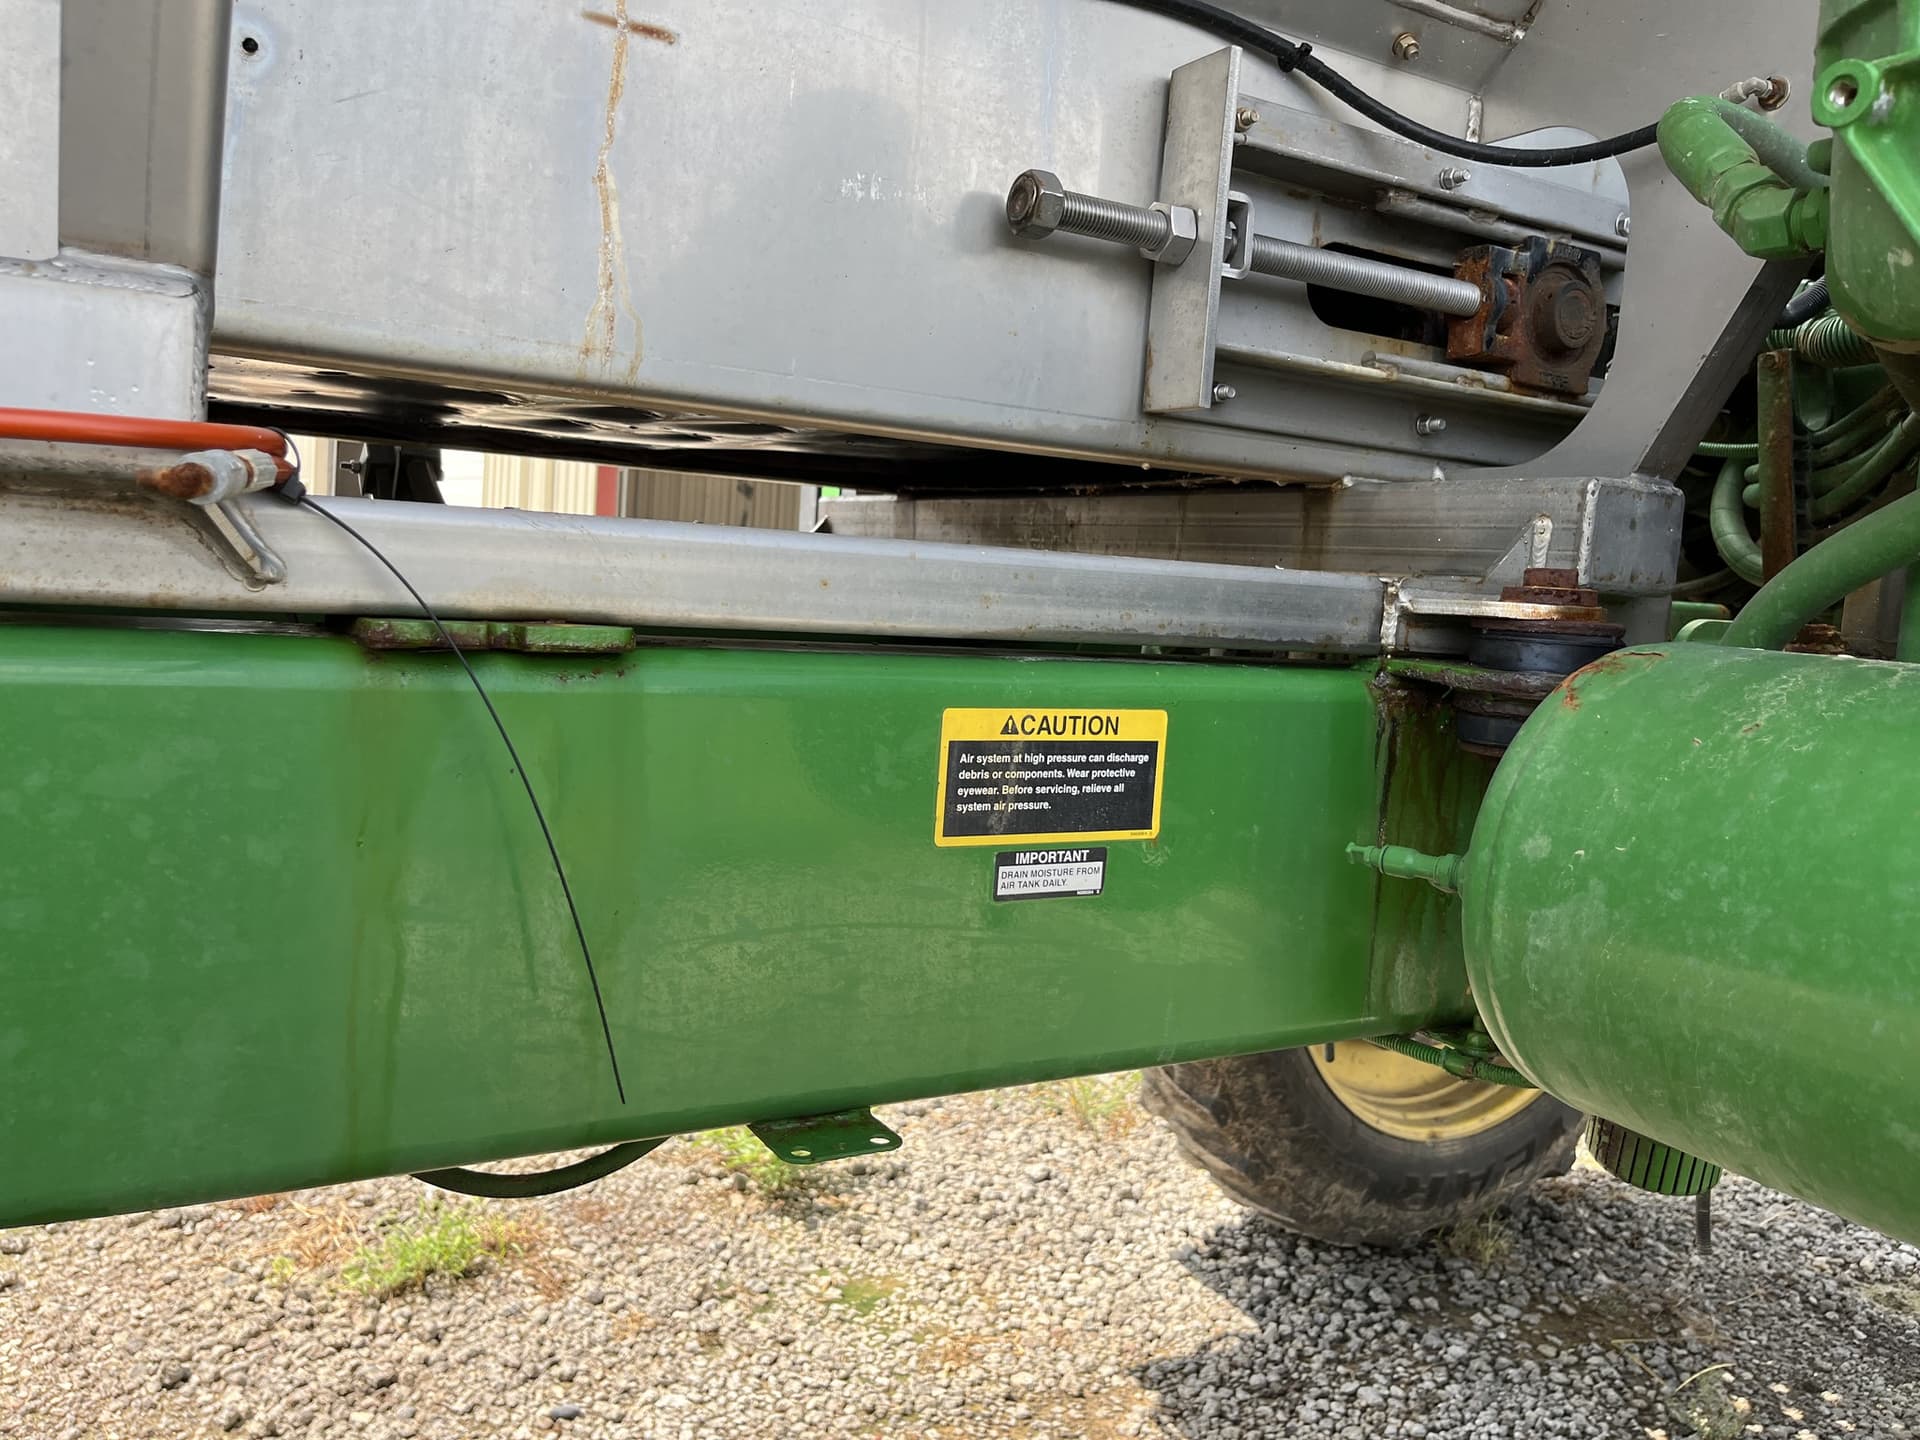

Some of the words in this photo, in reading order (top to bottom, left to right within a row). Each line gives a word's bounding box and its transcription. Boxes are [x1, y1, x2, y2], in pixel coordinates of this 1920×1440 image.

[1021, 715, 1119, 736] CAUTION
[960, 753, 974, 764] Air
[977, 754, 1010, 765] system
[1013, 754, 1022, 763] at
[1025, 753, 1044, 764] high
[1047, 754, 1086, 764] pressure
[1089, 754, 1104, 762] can
[1107, 752, 1149, 764] discharge
[959, 770, 989, 779] debris
[992, 771, 1002, 779] or
[1005, 769, 1064, 780] components.
[1067, 769, 1089, 778] Wear
[1092, 768, 1135, 780] protective
[958, 786, 999, 796] eyewear.
[1002, 785, 1033, 795] Before
[1036, 784, 1080, 796] servicing,
[1082, 784, 1111, 793] relieve
[1114, 783, 1124, 793] all
[956, 802, 991, 812] system
[994, 801, 1005, 811] air
[1008, 801, 1051, 811] pressure.
[1016, 850, 1089, 864] IMPORTANT
[1001, 870, 1028, 879] DRAIN
[1031, 867, 1073, 878] MOISTURE
[1077, 867, 1100, 875] FROM
[1000, 881, 1015, 890] AIR
[1018, 880, 1040, 888] TANK
